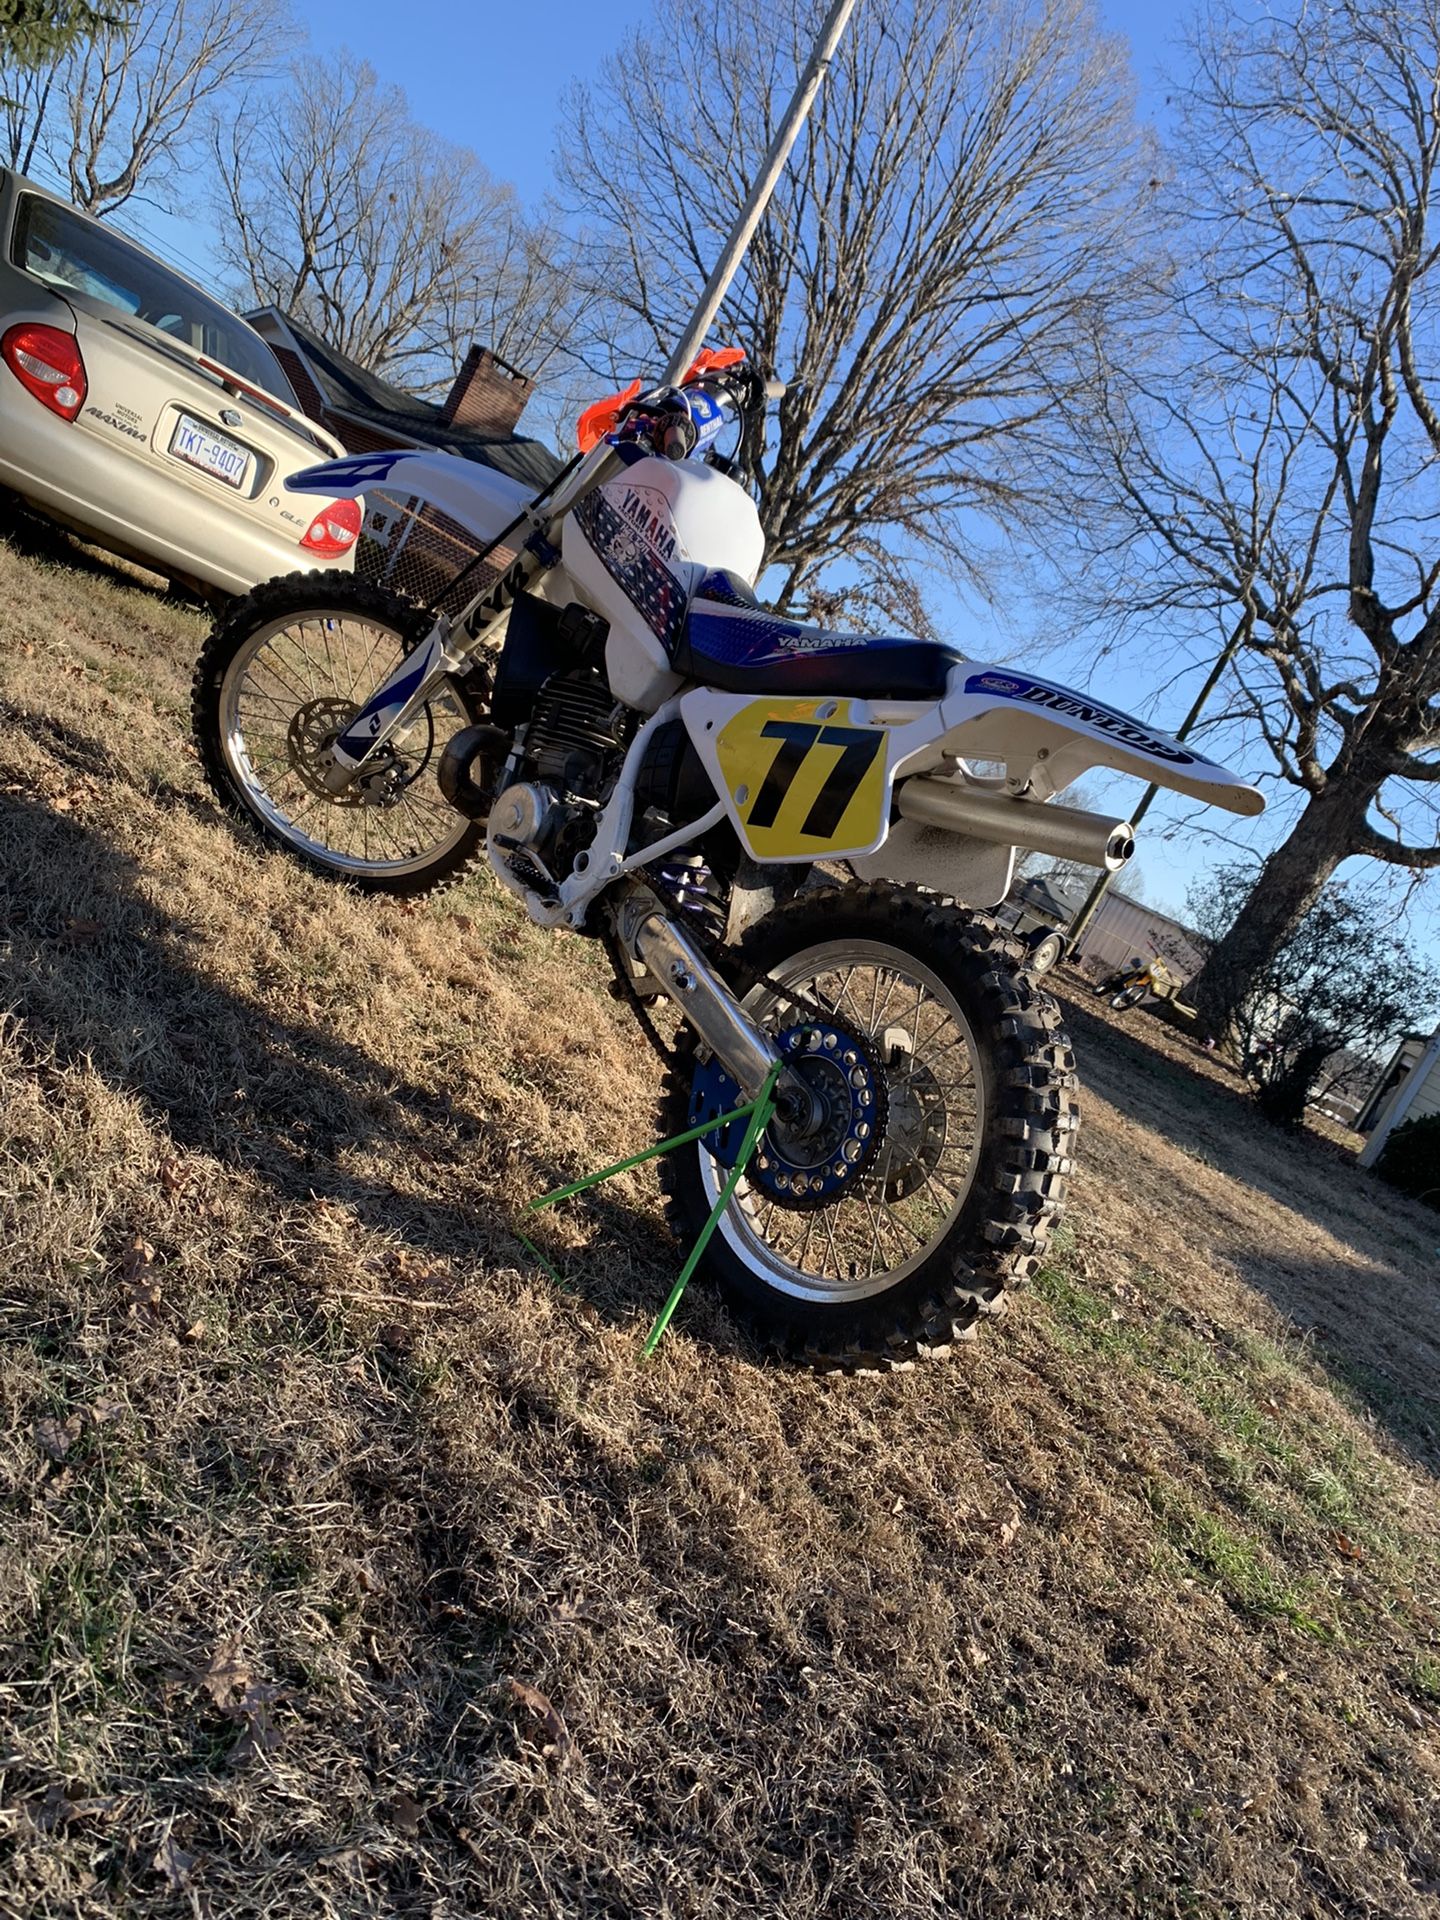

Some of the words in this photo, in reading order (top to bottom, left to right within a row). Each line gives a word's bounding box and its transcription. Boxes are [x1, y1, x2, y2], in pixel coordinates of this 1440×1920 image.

[85, 407, 147, 442] MAXIMA
[115, 402, 143, 421] UNIVERSAL
[179, 427, 245, 476] TKT-9407
[280, 510, 306, 527] GLE
[618, 505, 644, 533] FACTORY
[643, 532, 669, 562] RACING
[622, 488, 676, 559] YAMAHA
[463, 562, 530, 641] KYB
[777, 637, 868, 649] YAMAHA
[1012, 685, 1179, 755] DUNLOP
[746, 719, 886, 839] 77
